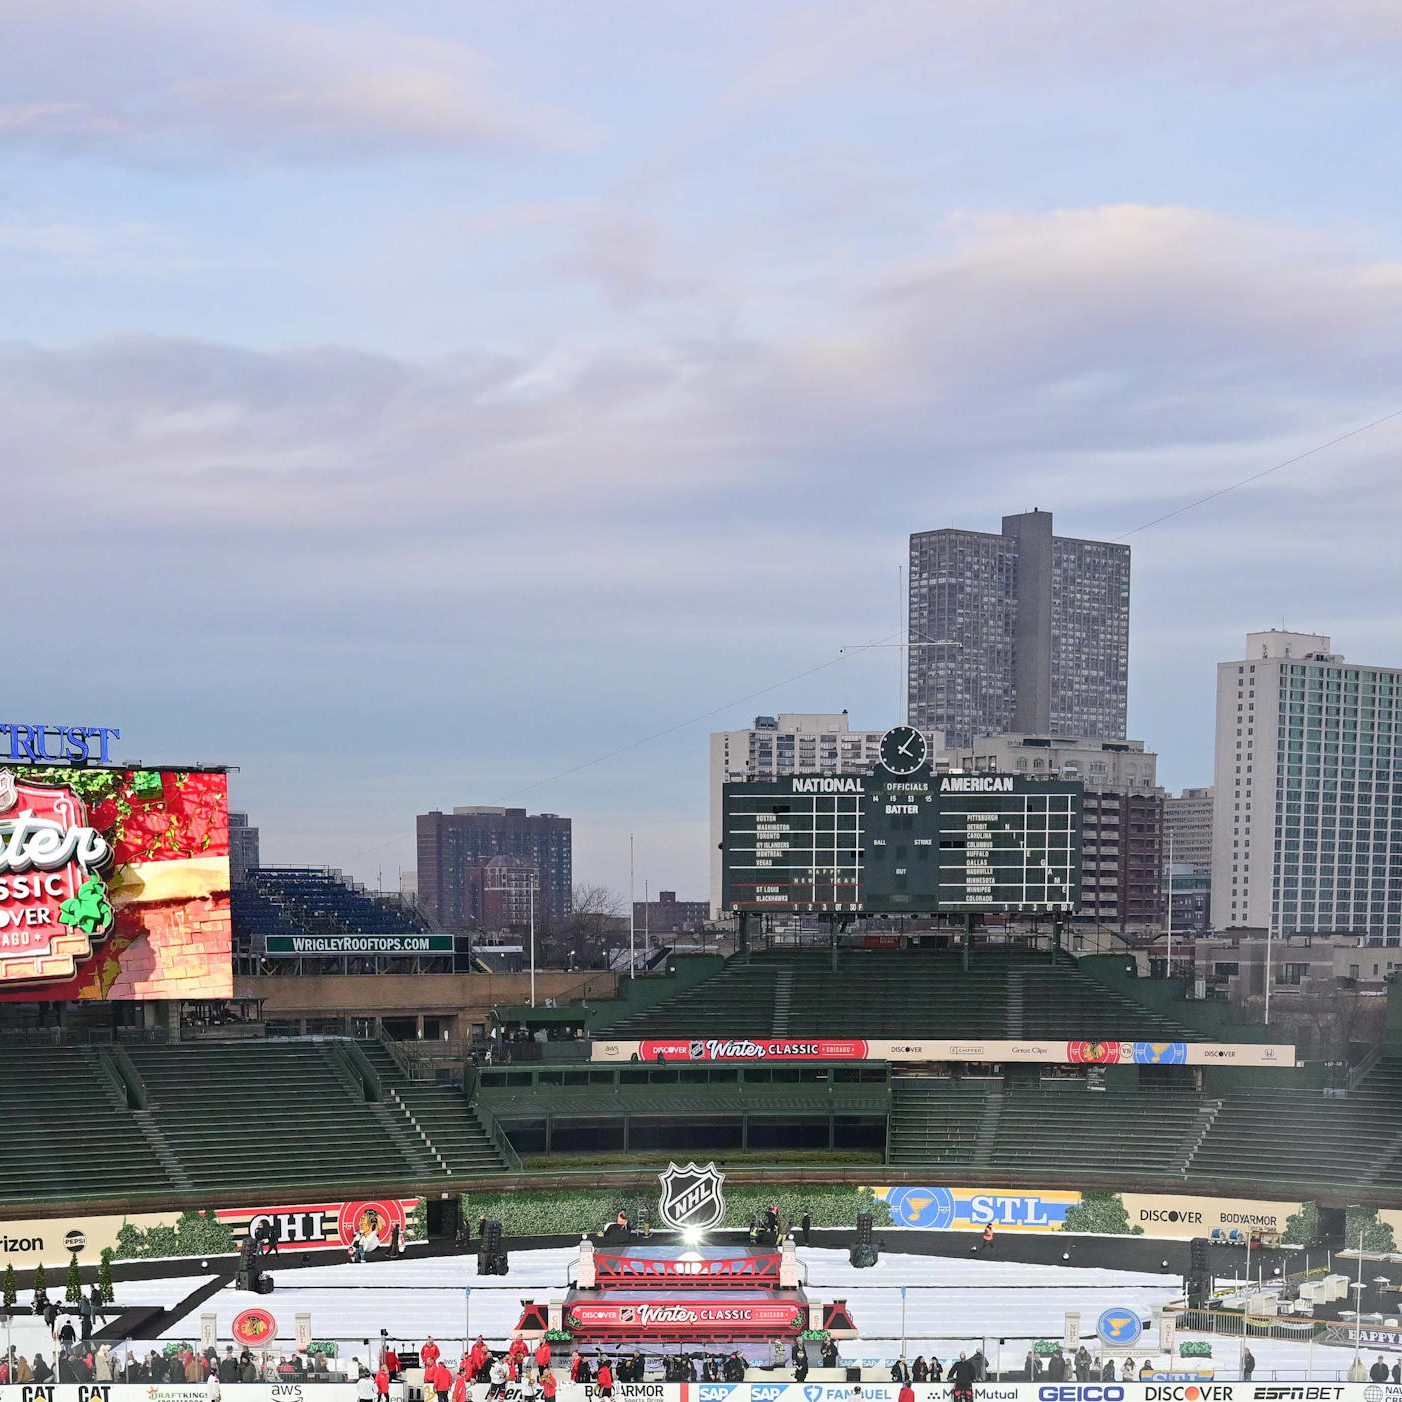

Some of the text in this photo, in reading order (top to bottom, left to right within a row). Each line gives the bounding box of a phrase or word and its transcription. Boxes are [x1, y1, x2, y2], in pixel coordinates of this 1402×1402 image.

[792, 778, 865, 792] NATIONAL
[887, 783, 928, 791] OFFICIALS
[940, 778, 1014, 792] AMERICAN
[885, 805, 918, 814] BATTER
[706, 1040, 766, 1060] Winter
[768, 1045, 819, 1055] CLASSIC
[675, 1186, 711, 1220] NHL
[971, 1195, 1047, 1225] STL
[1140, 1209, 1202, 1224] DISCOVER
[1220, 1213, 1277, 1226] BODYARMOR
[250, 1212, 326, 1242] CHI
[582, 1311, 617, 1319] DISCOVER
[637, 1304, 698, 1327] Winter
[700, 1309, 752, 1320] CLASSIC
[1348, 1329, 1396, 1343] HAPPY
[271, 1384, 302, 1397] aws
[700, 1387, 729, 1400] SAP
[751, 1387, 781, 1400] SAP
[826, 1389, 891, 1400] FANUEL
[1038, 1386, 1125, 1402] GEICO
[1145, 1386, 1233, 1401] DISCOVER
[1254, 1387, 1345, 1400] ESPN BET
